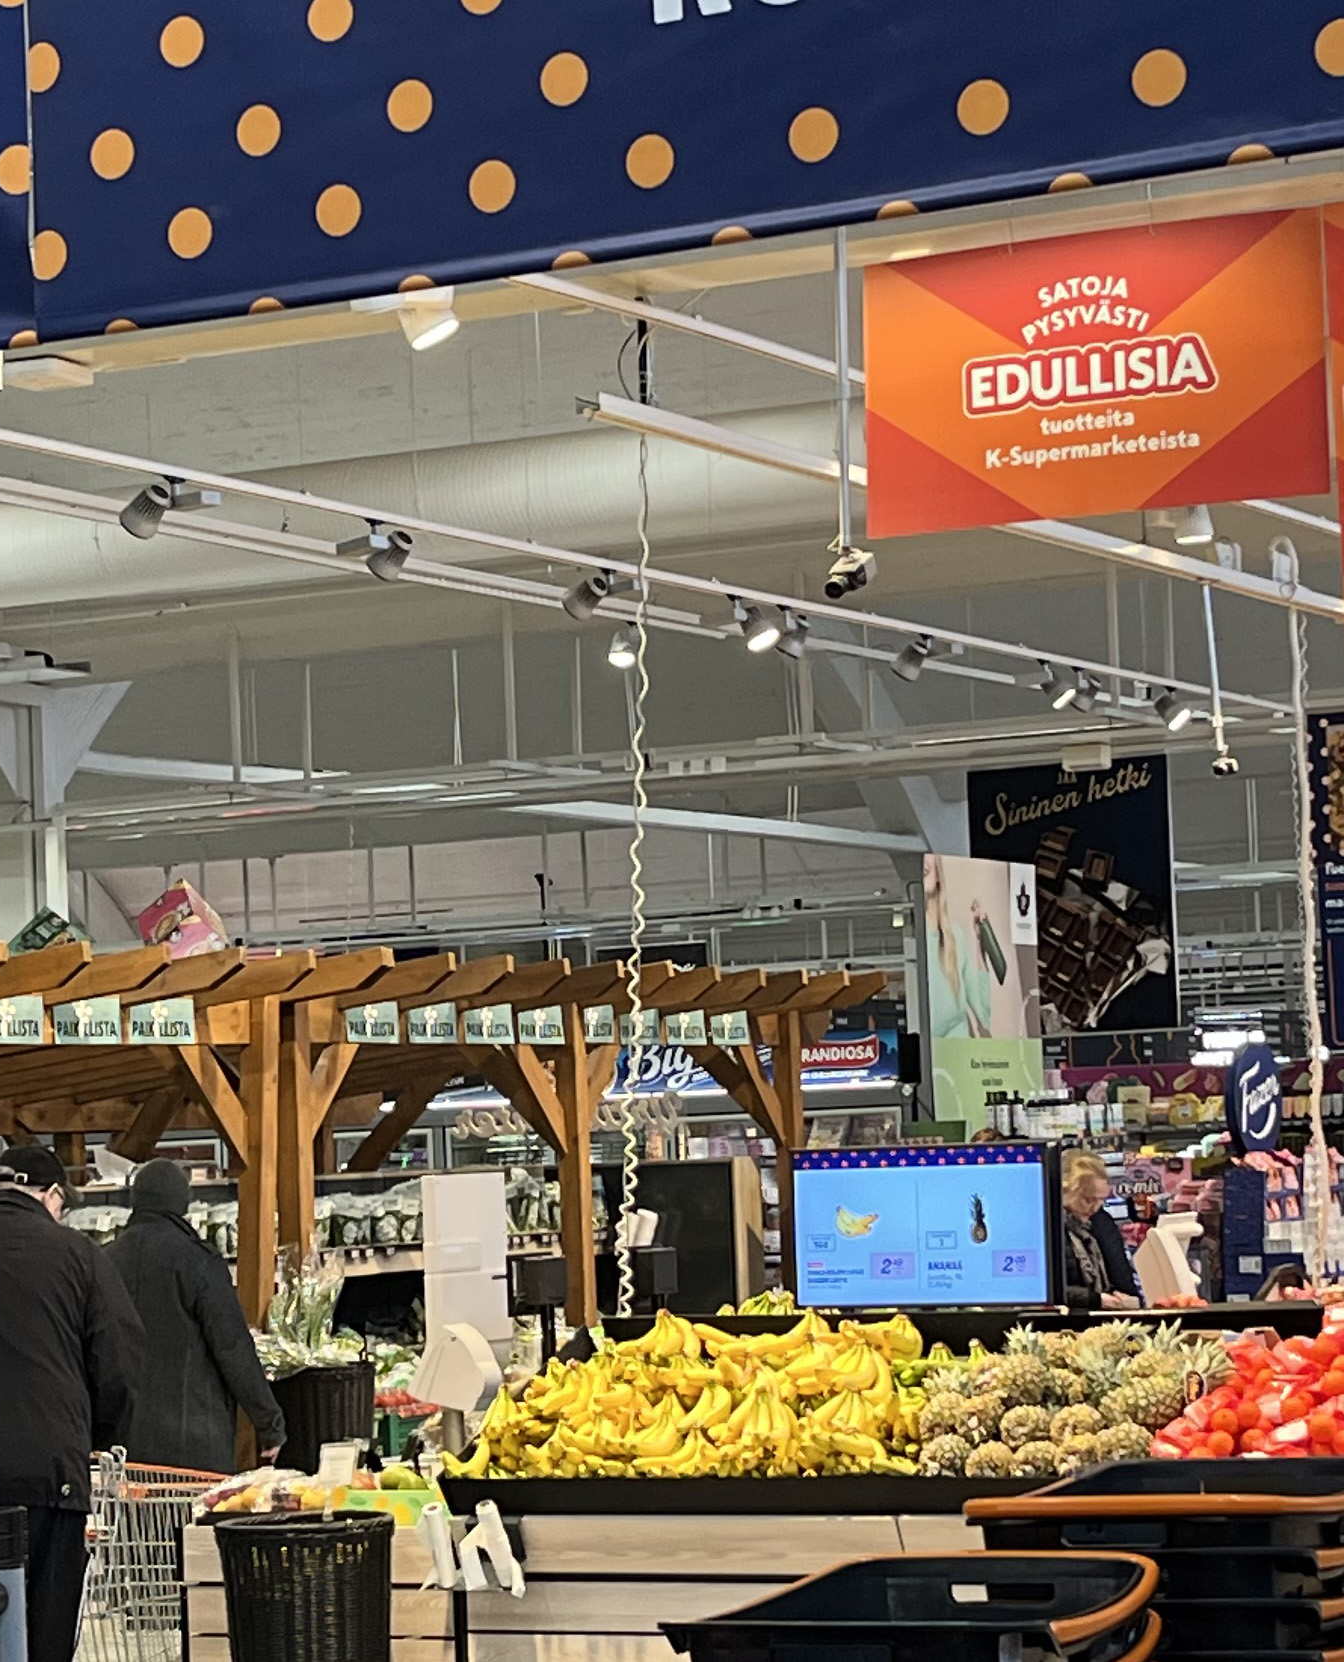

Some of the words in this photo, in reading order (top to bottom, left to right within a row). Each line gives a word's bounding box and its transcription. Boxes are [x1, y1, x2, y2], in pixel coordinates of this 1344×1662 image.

[1038, 276, 1128, 308] SATOJA
[1021, 299, 1149, 345] PYSYVÄSTI
[970, 343, 1208, 408] EDULLISIA
[1040, 409, 1135, 435] tuotteita
[985, 431, 1200, 469] K-Supermarketeista
[984, 790, 1081, 836] Sininen
[1086, 762, 1152, 804] hetki
